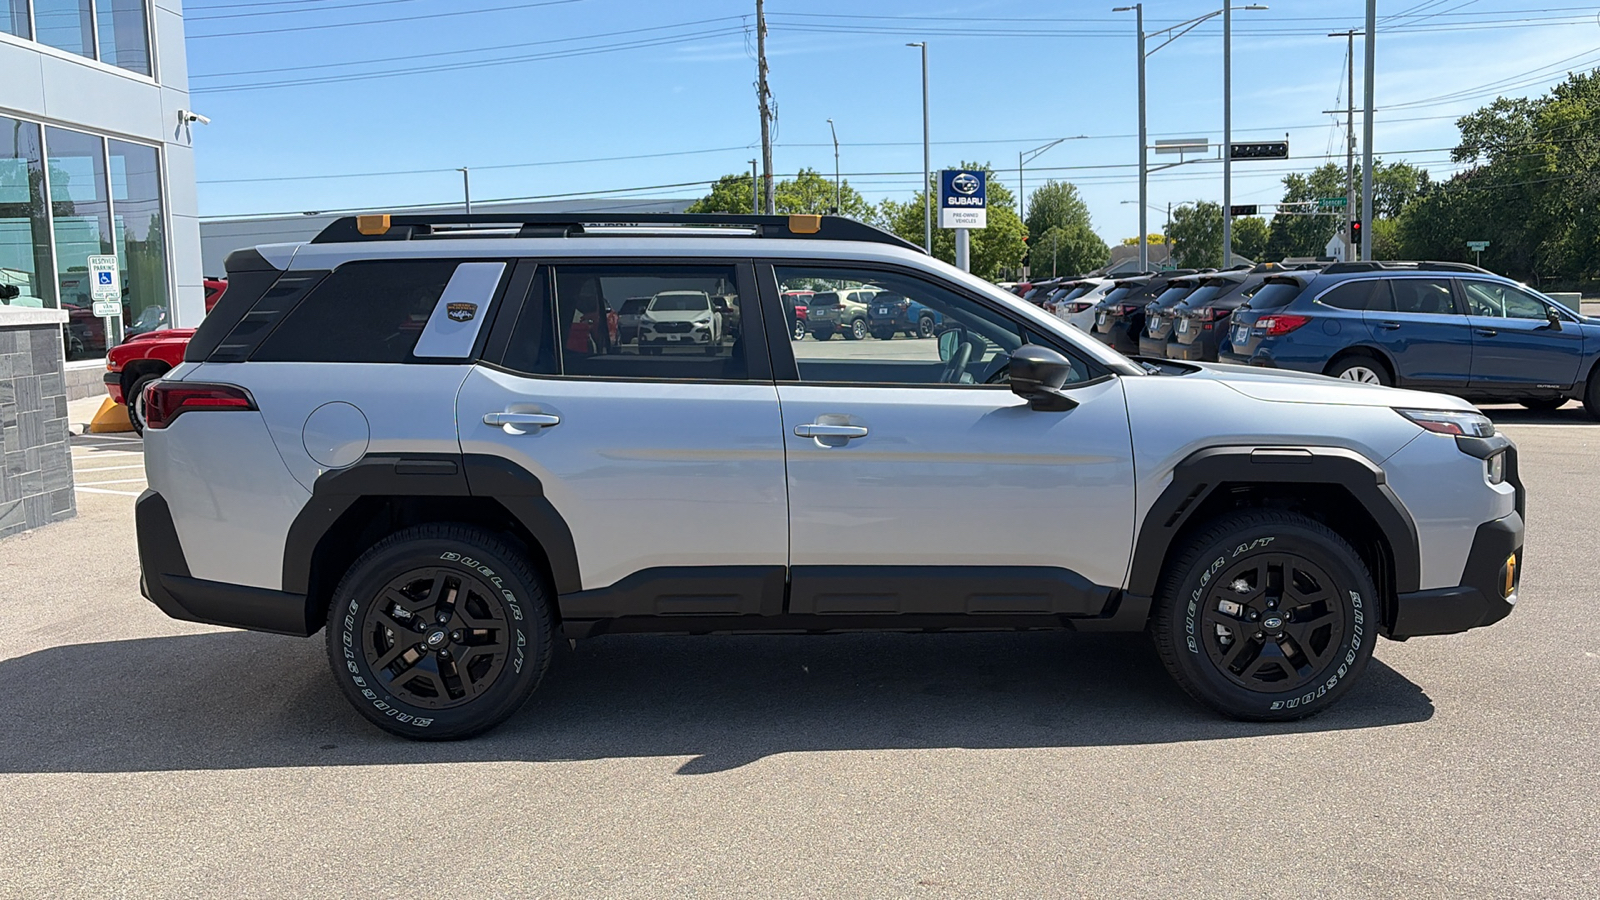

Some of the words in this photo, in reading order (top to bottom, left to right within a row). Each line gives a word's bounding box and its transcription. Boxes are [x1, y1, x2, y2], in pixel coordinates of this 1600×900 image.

[948, 196, 983, 205] SUBARU
[439, 551, 524, 621] DUELER
[512, 628, 526, 674] A/T
[1185, 556, 1225, 654] DUELER
[1232, 536, 1275, 558] A/T
[1269, 589, 1364, 710] BRIDGESTONE
[343, 599, 434, 728] BRIDGESTONE
